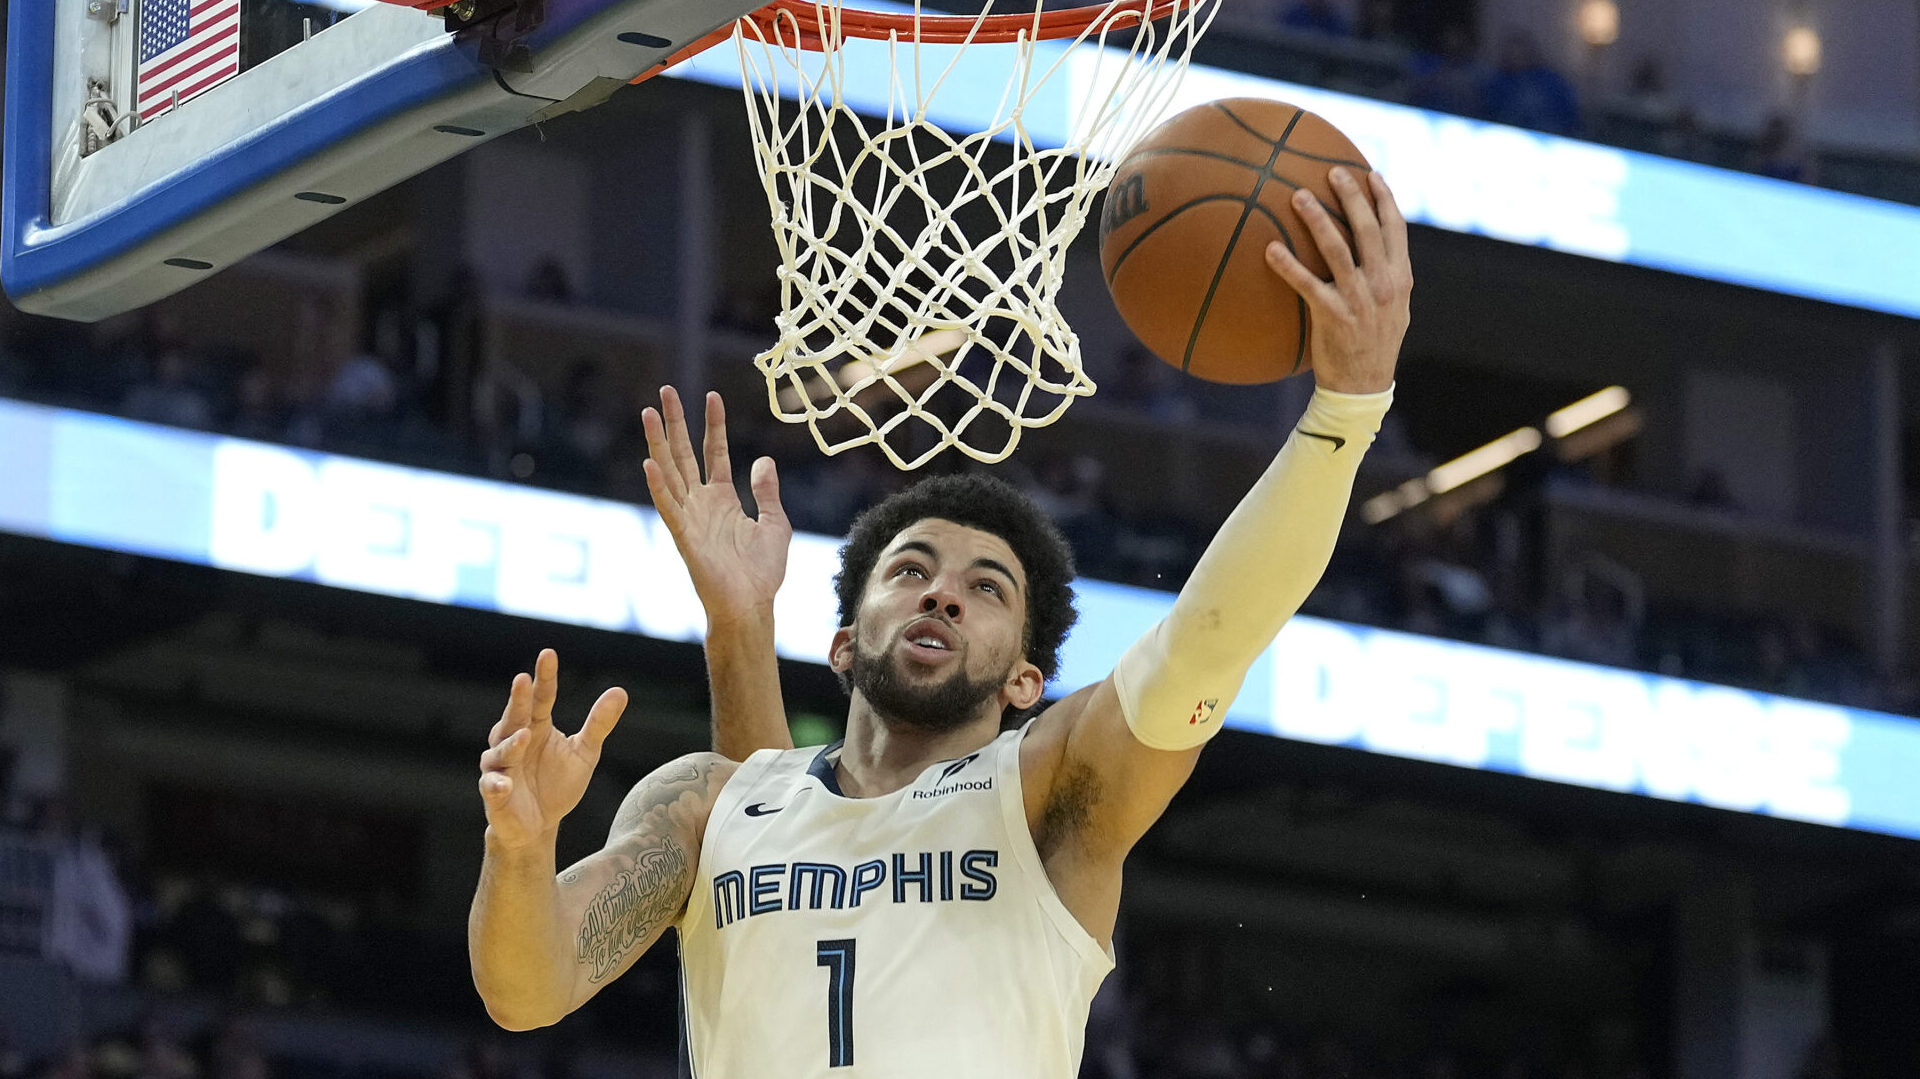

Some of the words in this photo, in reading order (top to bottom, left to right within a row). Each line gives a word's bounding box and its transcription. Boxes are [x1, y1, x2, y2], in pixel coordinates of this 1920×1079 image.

[913, 776, 993, 800] Robinhood
[713, 849, 999, 930] MEMPHIS
[816, 938, 857, 1068] 1
